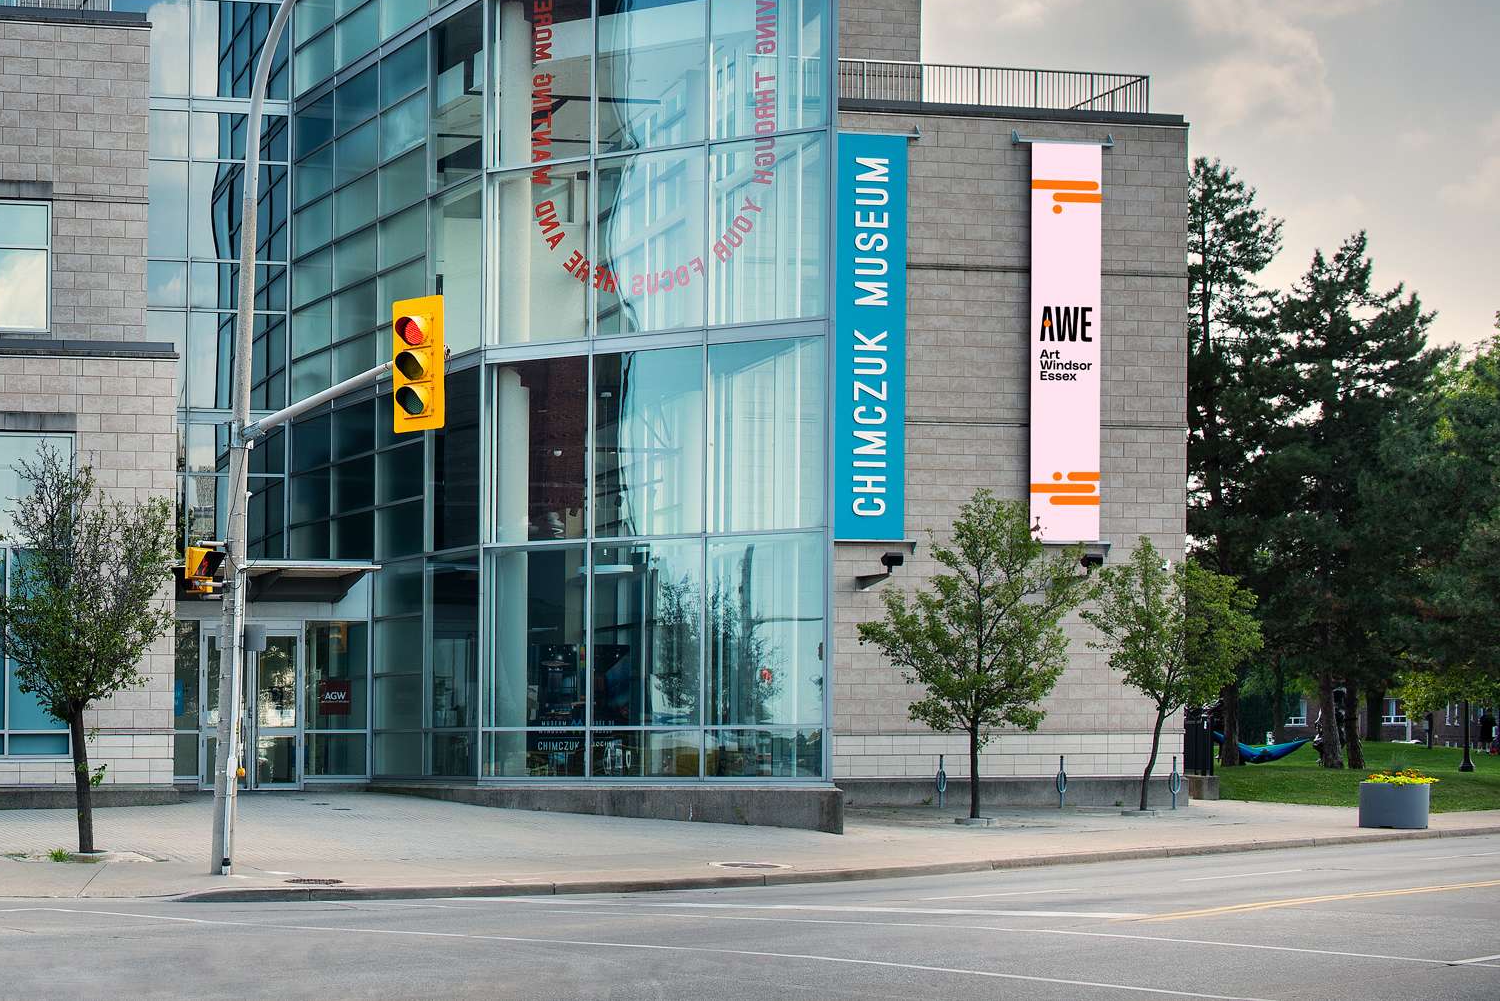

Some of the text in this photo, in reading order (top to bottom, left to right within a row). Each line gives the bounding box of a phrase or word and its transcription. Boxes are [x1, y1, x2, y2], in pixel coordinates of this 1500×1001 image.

[1039, 306, 1093, 342] AWE
[852, 157, 889, 517] CHIMCZUK MUSEUM
[1040, 349, 1060, 359] Art
[1040, 360, 1092, 370] Windsor
[1040, 370, 1077, 381] Essex
[324, 691, 347, 700] AGW
[537, 741, 580, 751] CHIMCZUK
